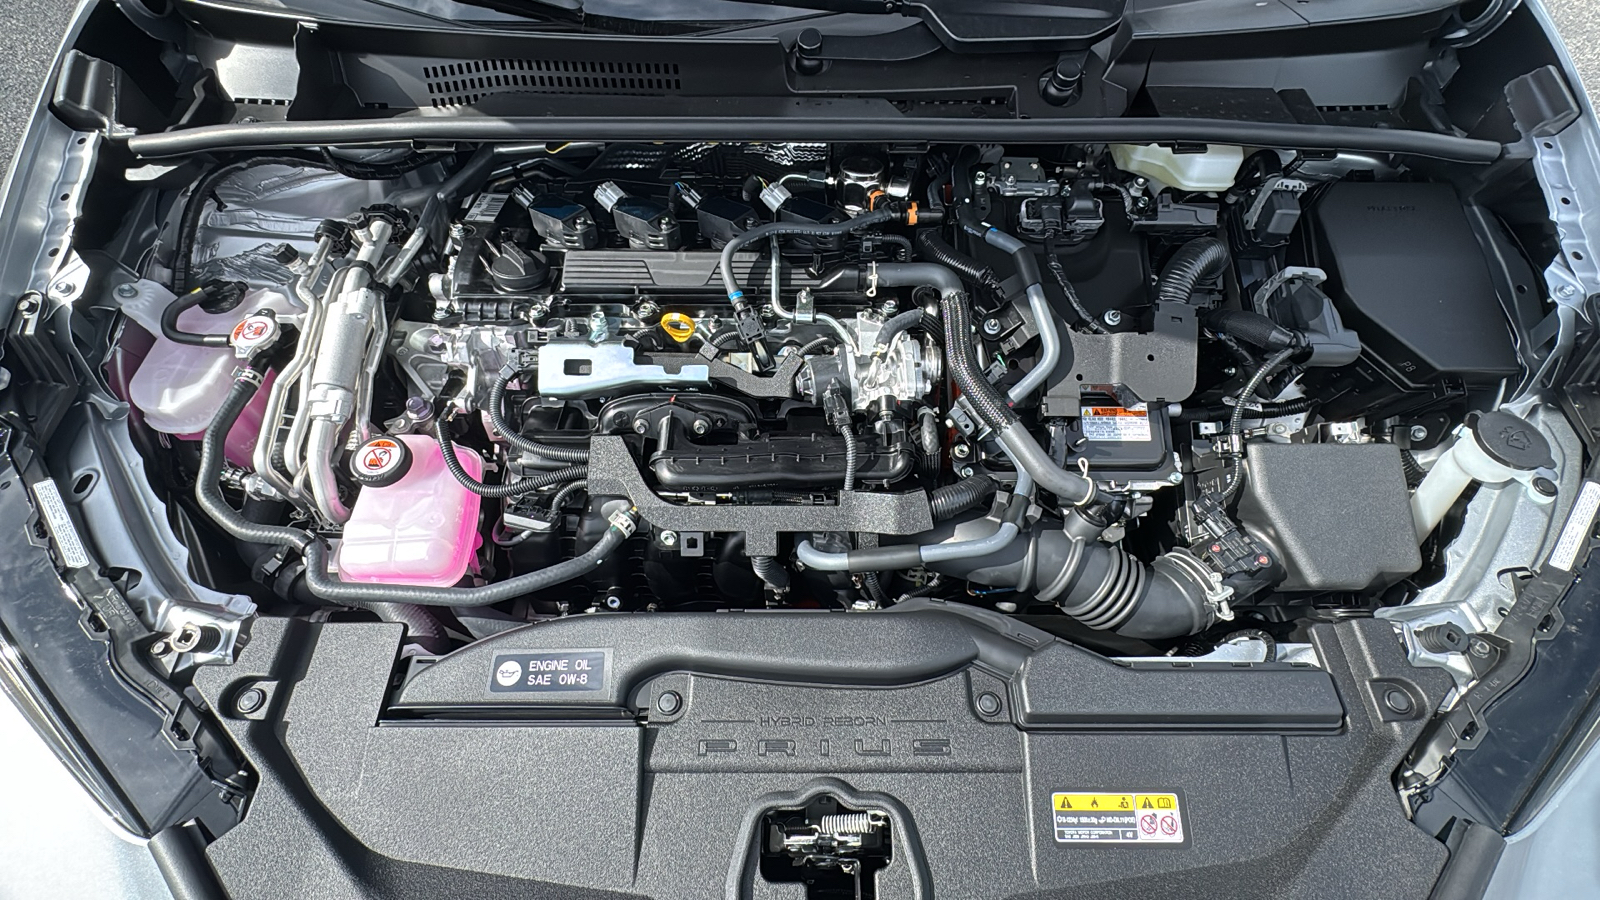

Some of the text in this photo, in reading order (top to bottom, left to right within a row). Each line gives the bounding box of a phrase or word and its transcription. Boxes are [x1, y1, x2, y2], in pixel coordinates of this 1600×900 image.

[529, 659, 592, 672] ENGINE OIL
[527, 673, 588, 686] SAE 0W-8
[759, 716, 887, 727] HYBRID REBORN
[697, 738, 952, 757] PRIUS
